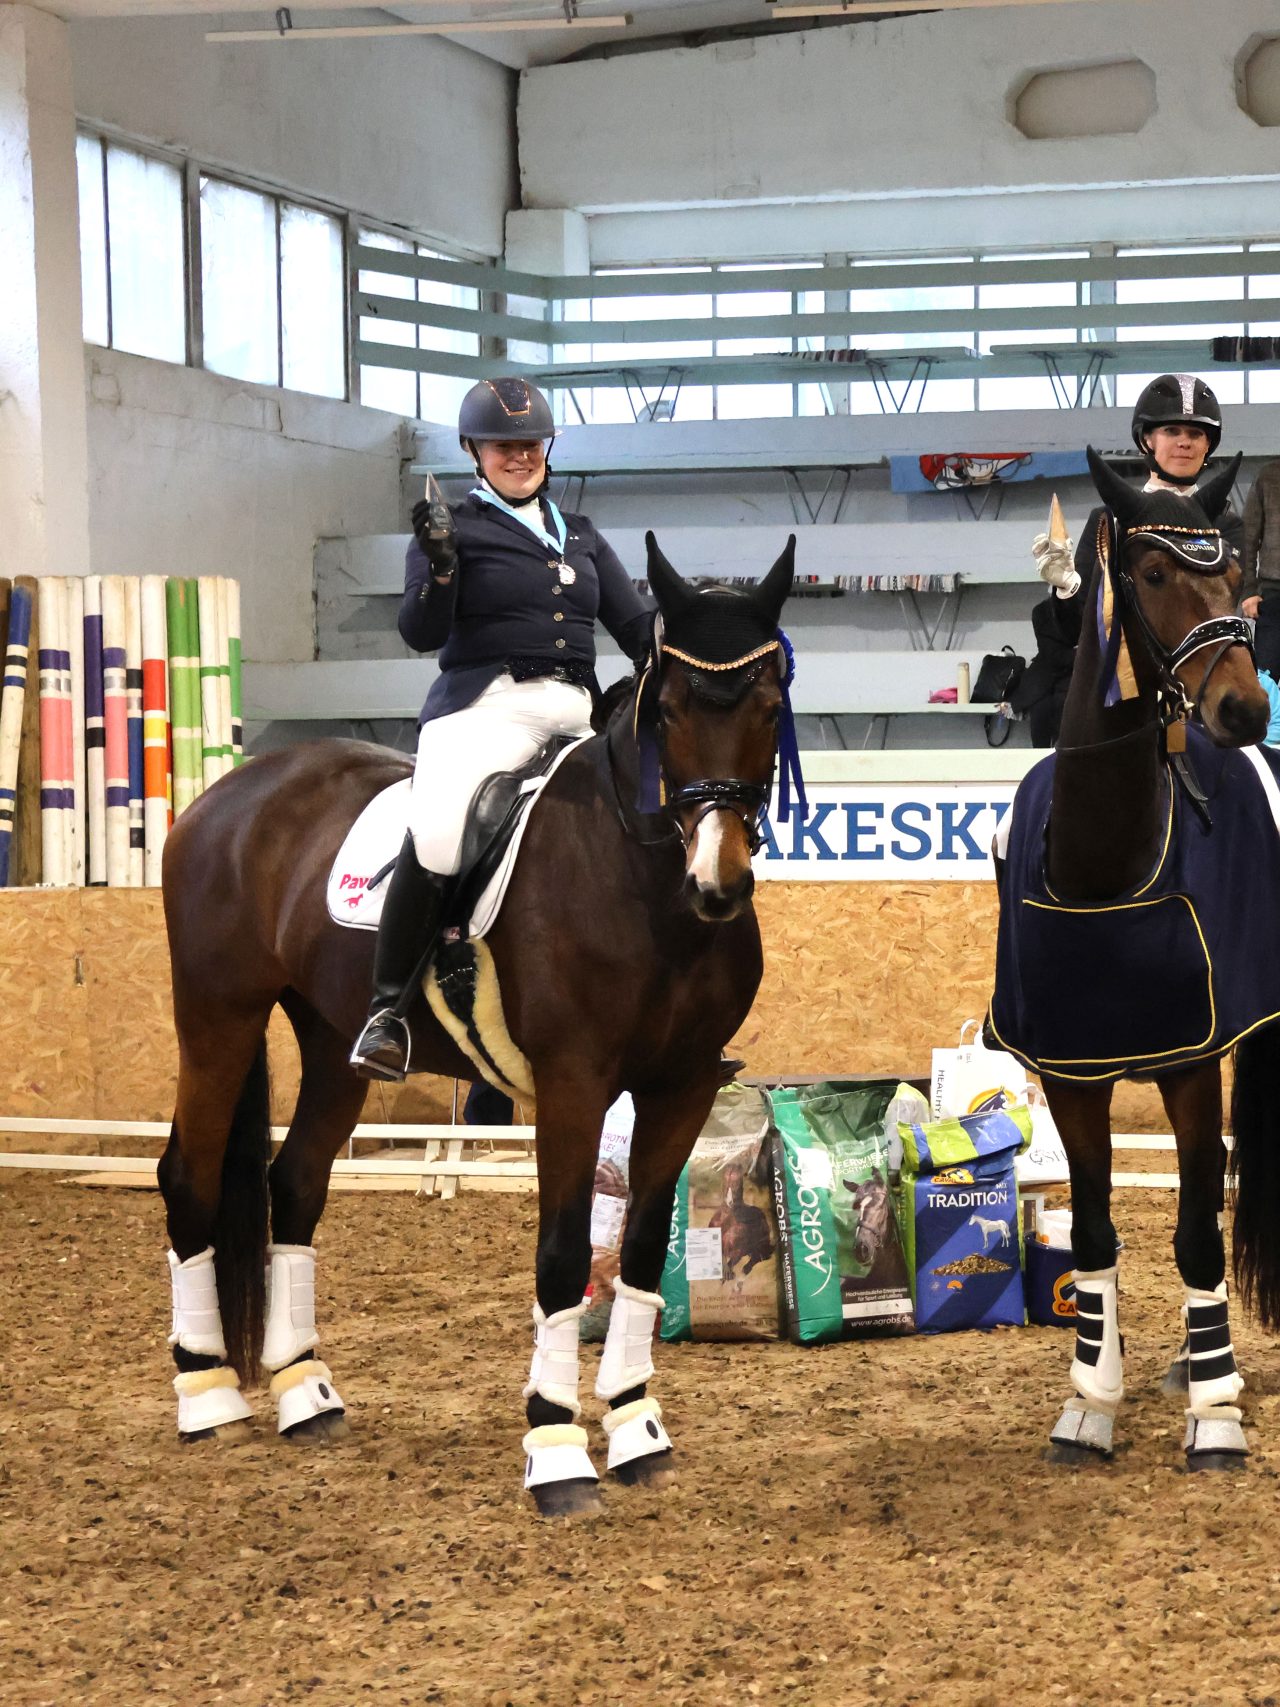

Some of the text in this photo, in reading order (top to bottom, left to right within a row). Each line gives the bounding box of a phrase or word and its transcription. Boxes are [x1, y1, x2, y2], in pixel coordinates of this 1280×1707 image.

[757, 802, 1012, 861] AKESK
[934, 1069, 945, 1114] HEALTHY
[927, 1190, 1008, 1209] TRADITION
